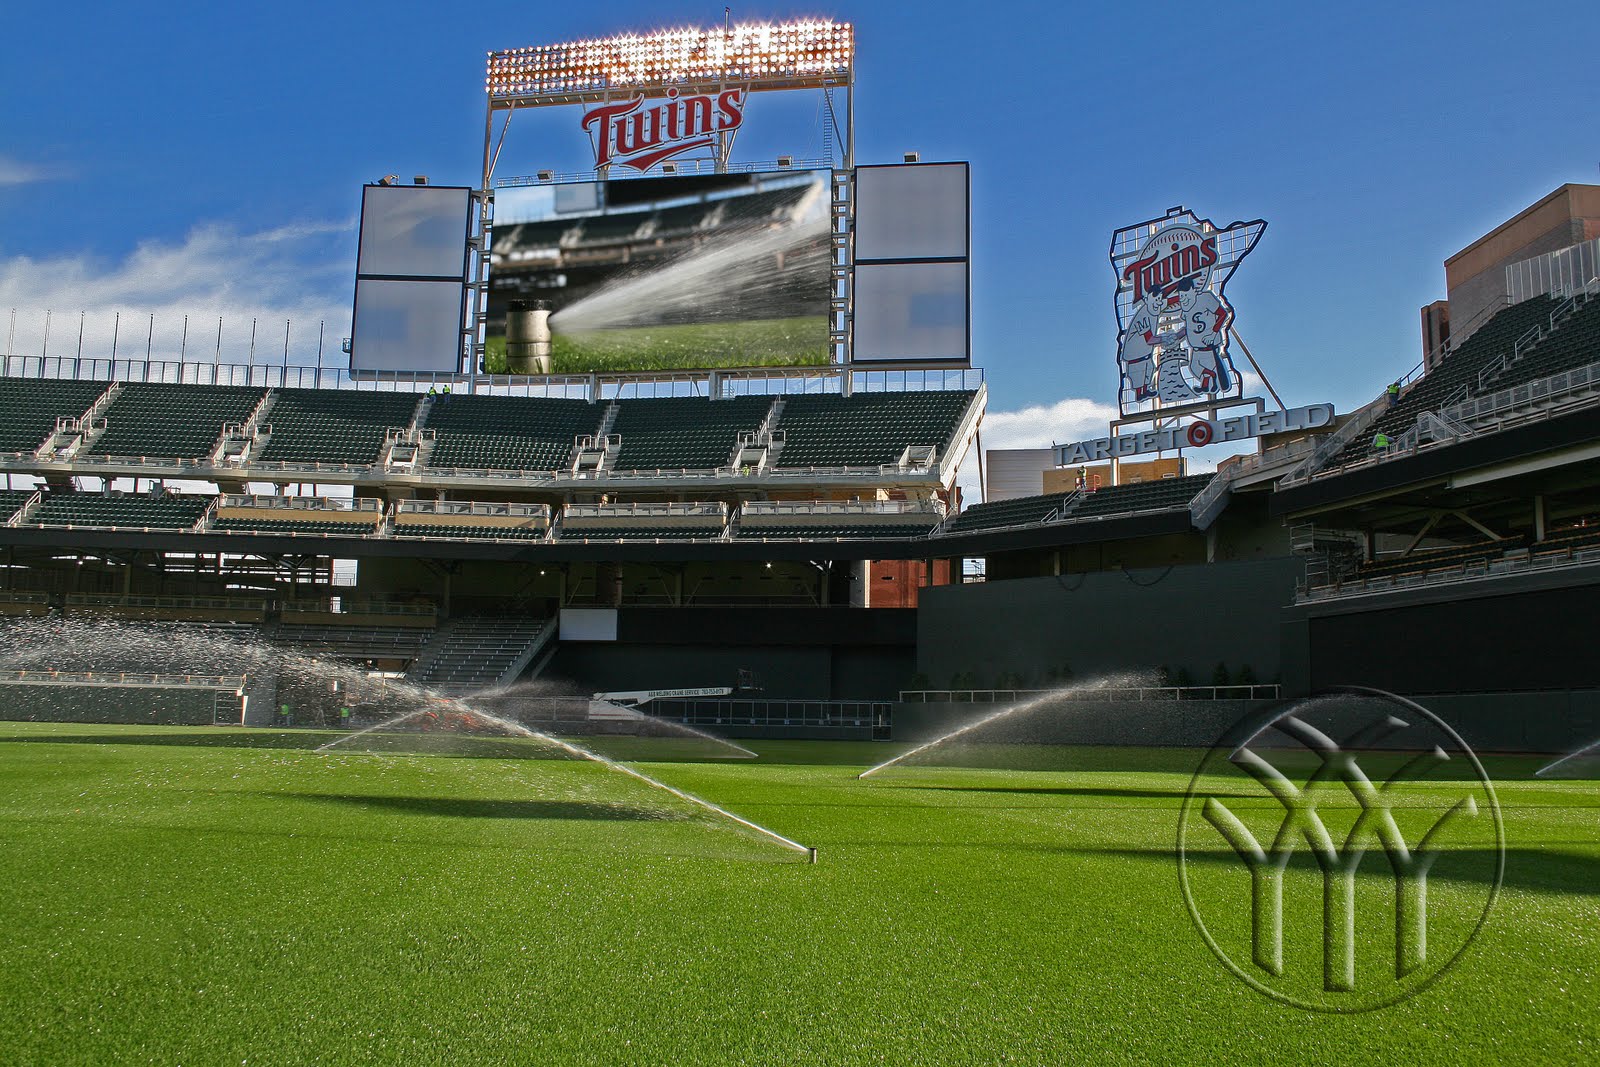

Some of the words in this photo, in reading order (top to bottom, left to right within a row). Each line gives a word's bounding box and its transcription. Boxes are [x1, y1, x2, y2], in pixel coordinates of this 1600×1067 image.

[582, 87, 743, 171] Twins
[1123, 237, 1218, 304] Twins
[1051, 426, 1182, 466] TARGET
[1222, 403, 1333, 441] FIELD
